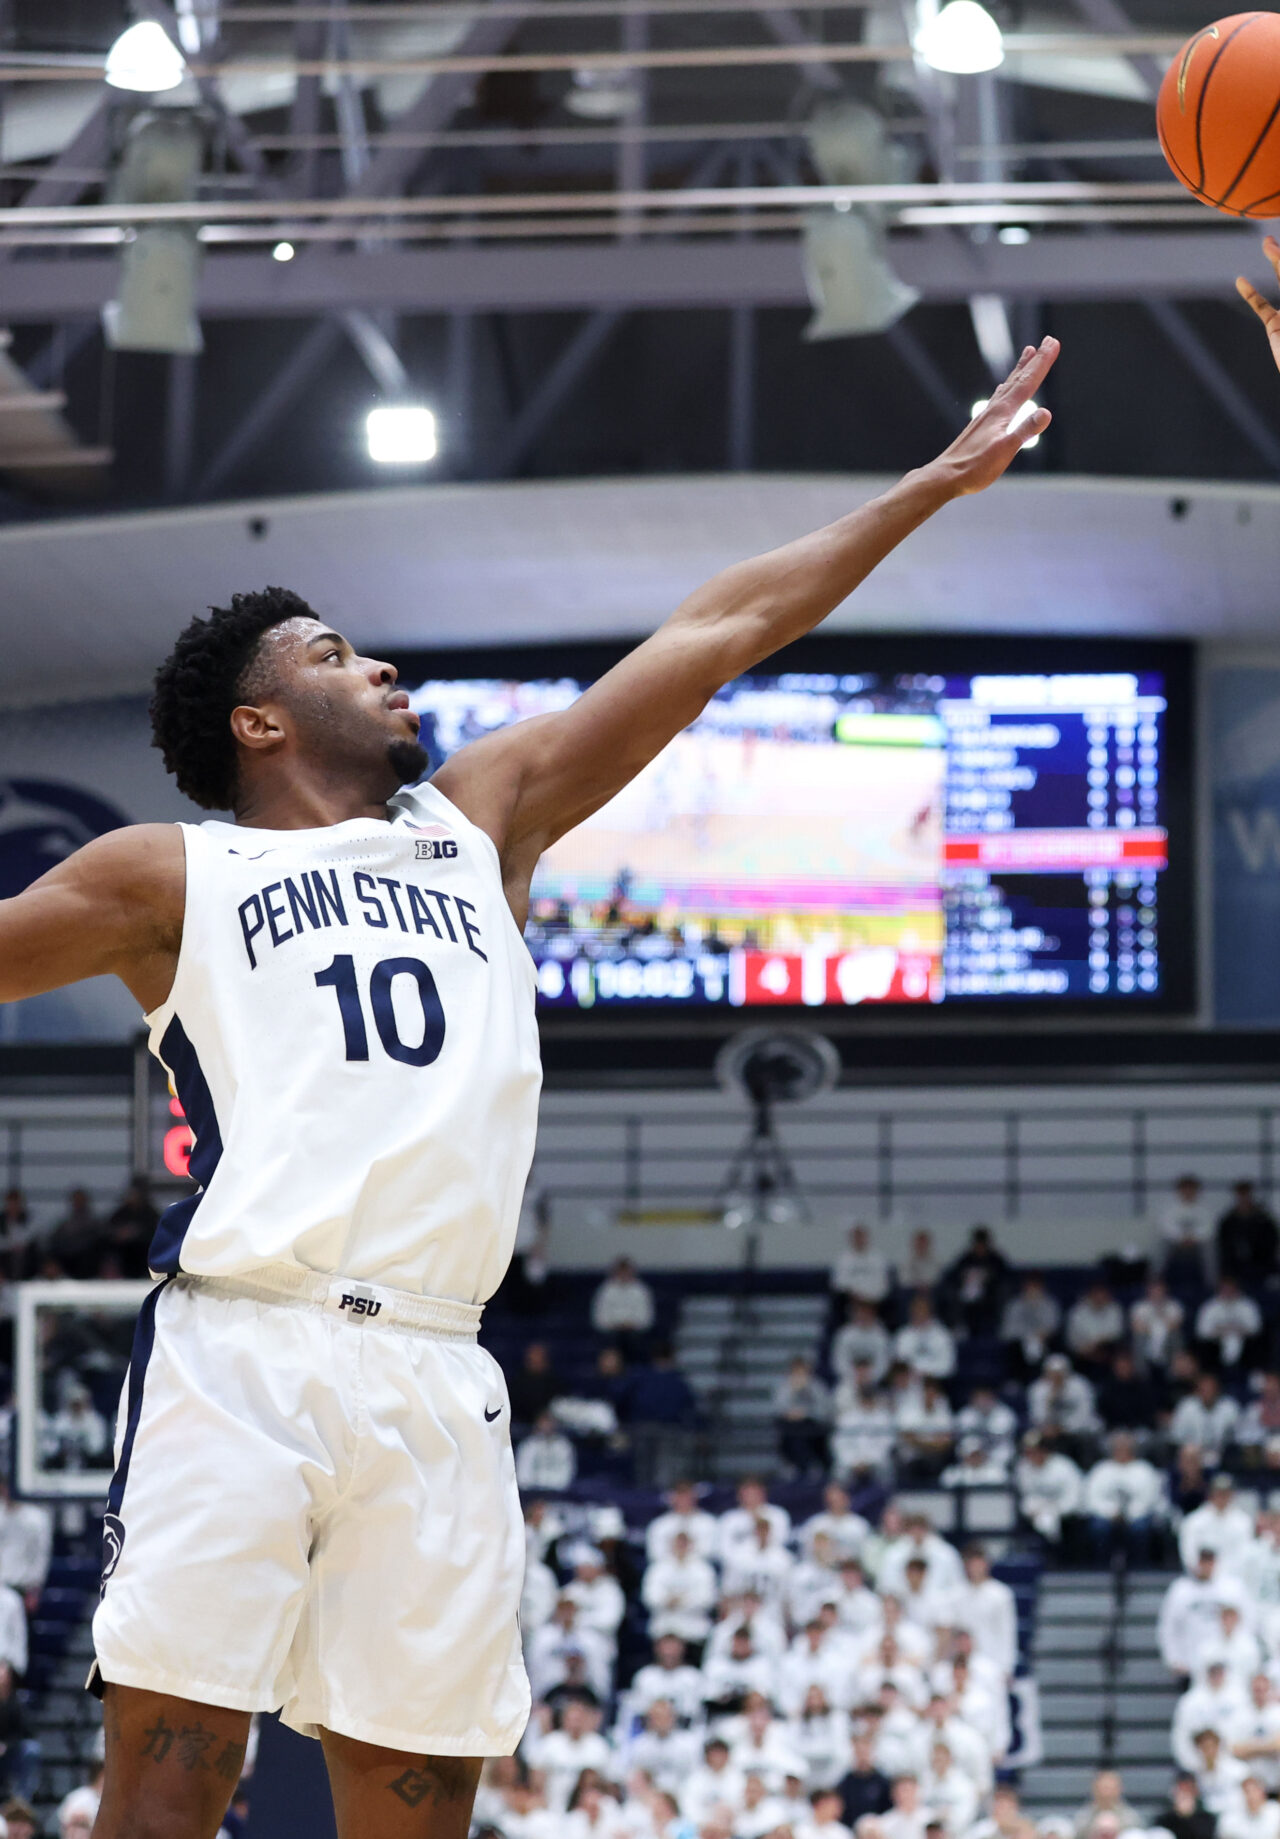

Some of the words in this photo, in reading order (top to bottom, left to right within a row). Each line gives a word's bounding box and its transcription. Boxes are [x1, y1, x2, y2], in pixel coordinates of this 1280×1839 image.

[237, 868, 350, 971] PENN
[352, 870, 489, 964] STATE
[313, 954, 447, 1068] 10
[338, 1293, 382, 1318] PSU
